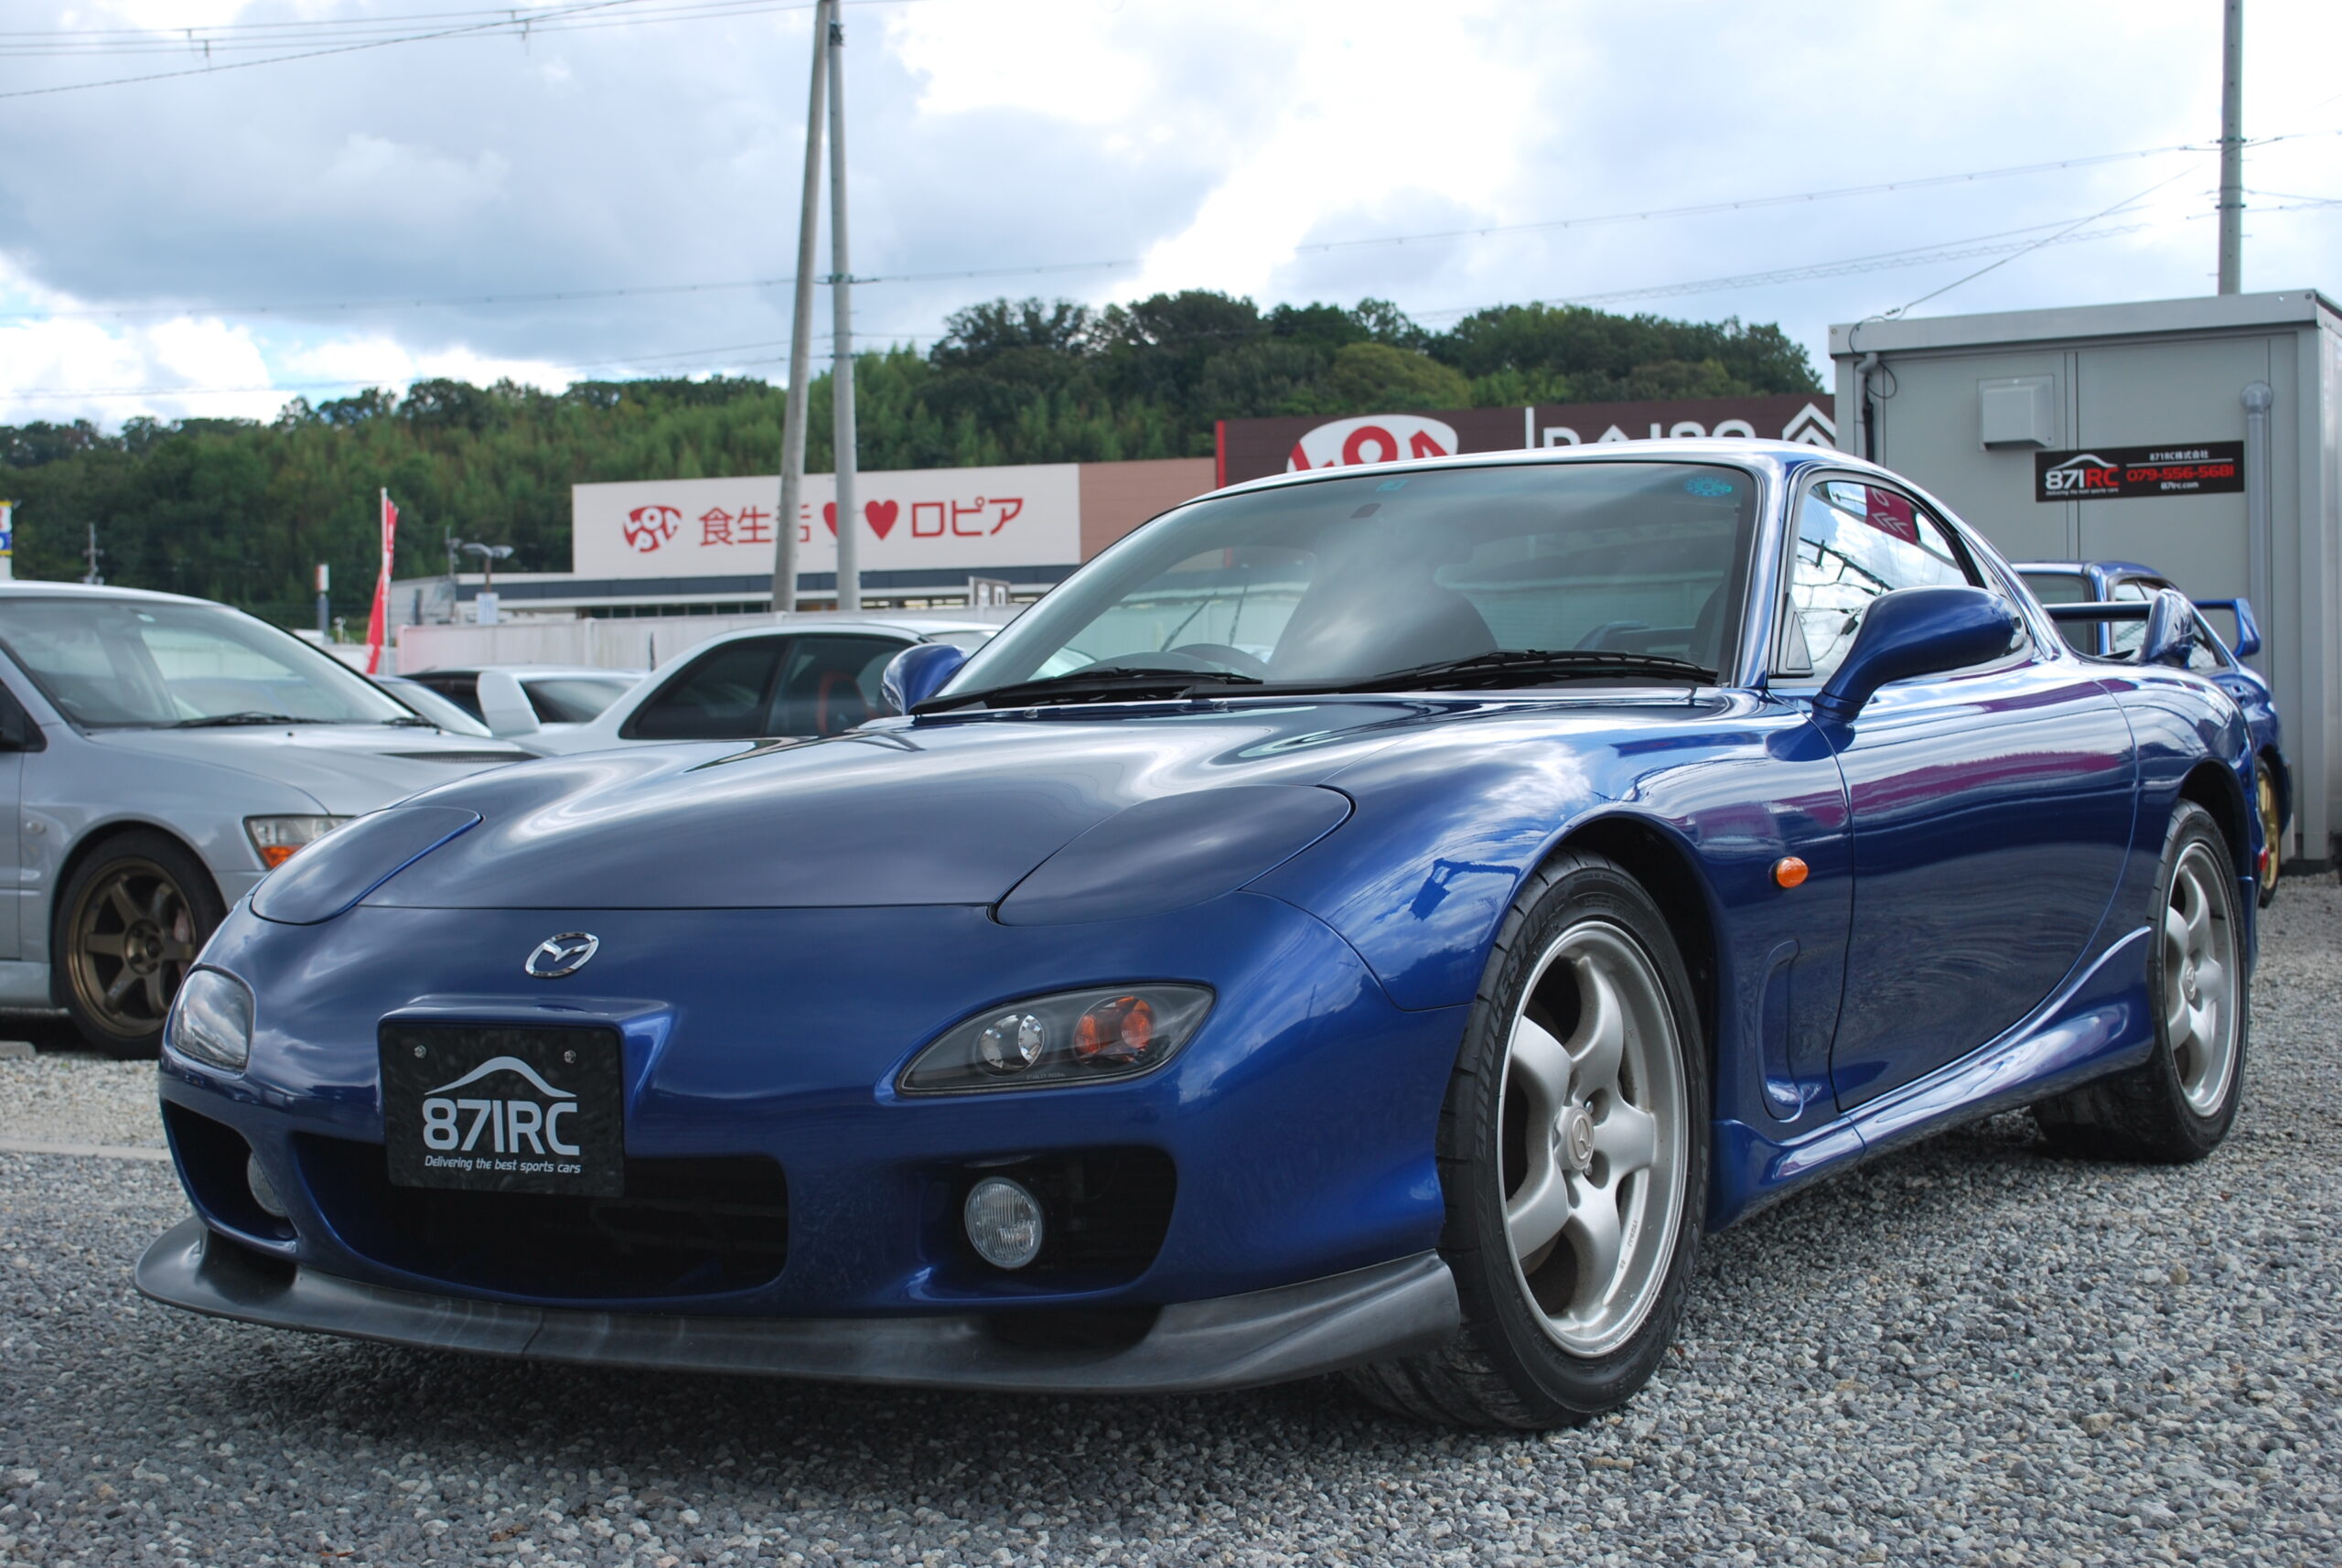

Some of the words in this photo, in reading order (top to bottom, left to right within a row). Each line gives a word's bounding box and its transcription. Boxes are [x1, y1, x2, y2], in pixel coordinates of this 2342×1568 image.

[2126, 465, 2234, 482] 079-556-5681
[912, 496, 1024, 538] ロピア
[424, 1155, 472, 1172] Delivering
[476, 1157, 491, 1169] the
[494, 1158, 517, 1172] best
[520, 1160, 554, 1175] sports
[557, 1163, 582, 1174] cars
